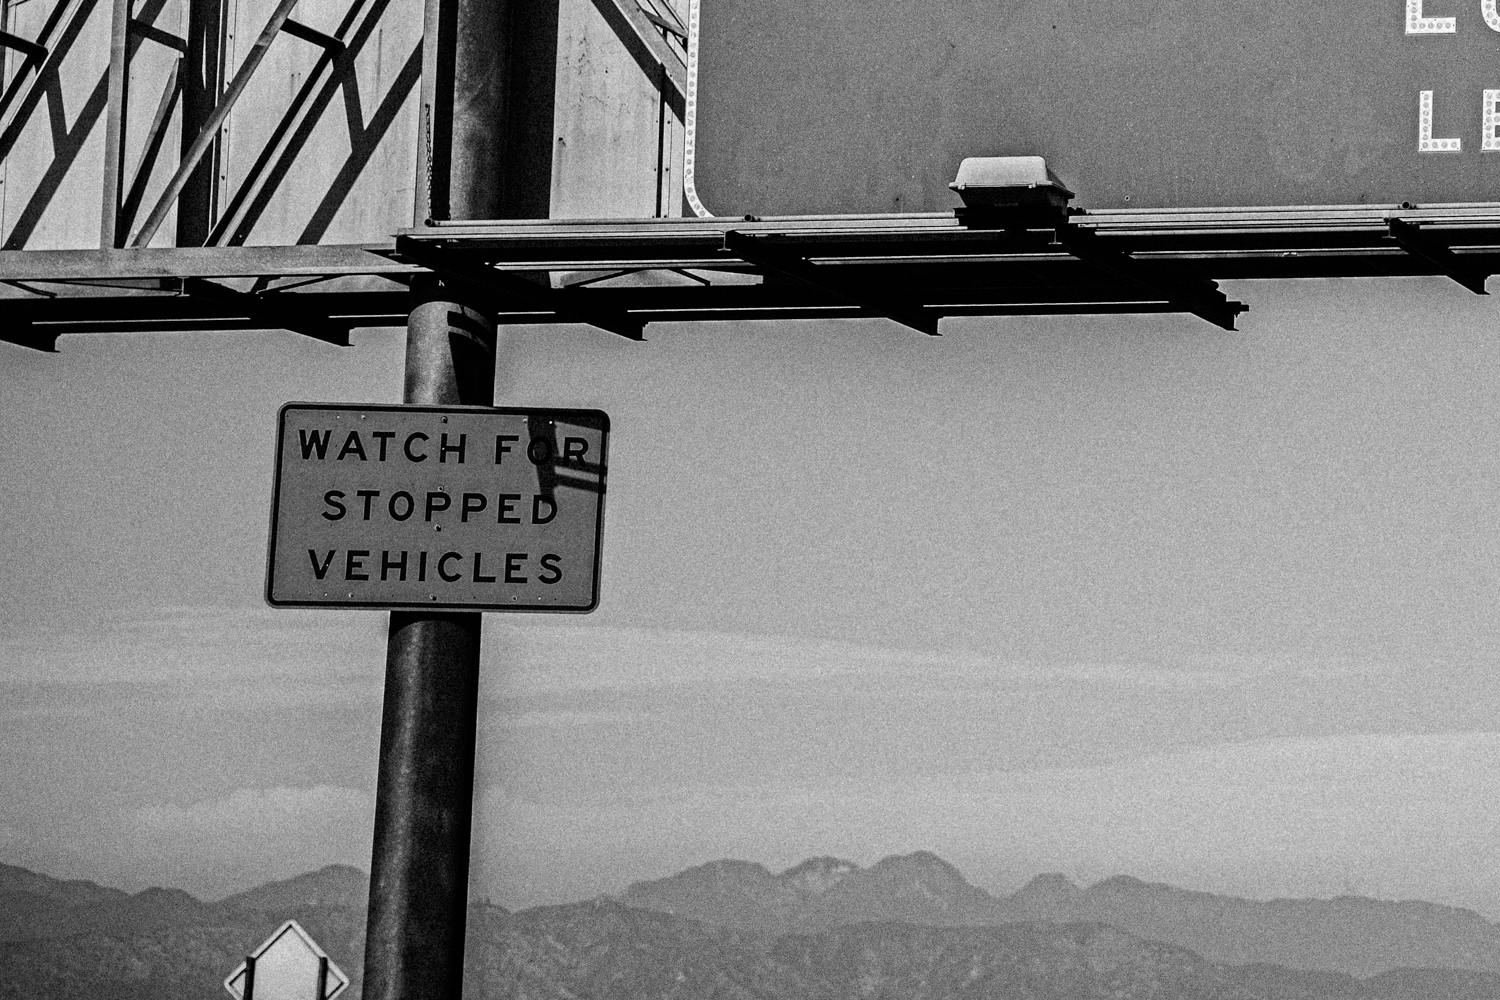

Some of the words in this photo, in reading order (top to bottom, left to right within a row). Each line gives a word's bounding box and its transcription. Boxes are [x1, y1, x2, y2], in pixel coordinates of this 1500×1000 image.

[299, 428, 467, 464] WATCH
[494, 434, 590, 467] FOR
[320, 489, 558, 525] STOPPED
[307, 549, 563, 585] VEHICLES
